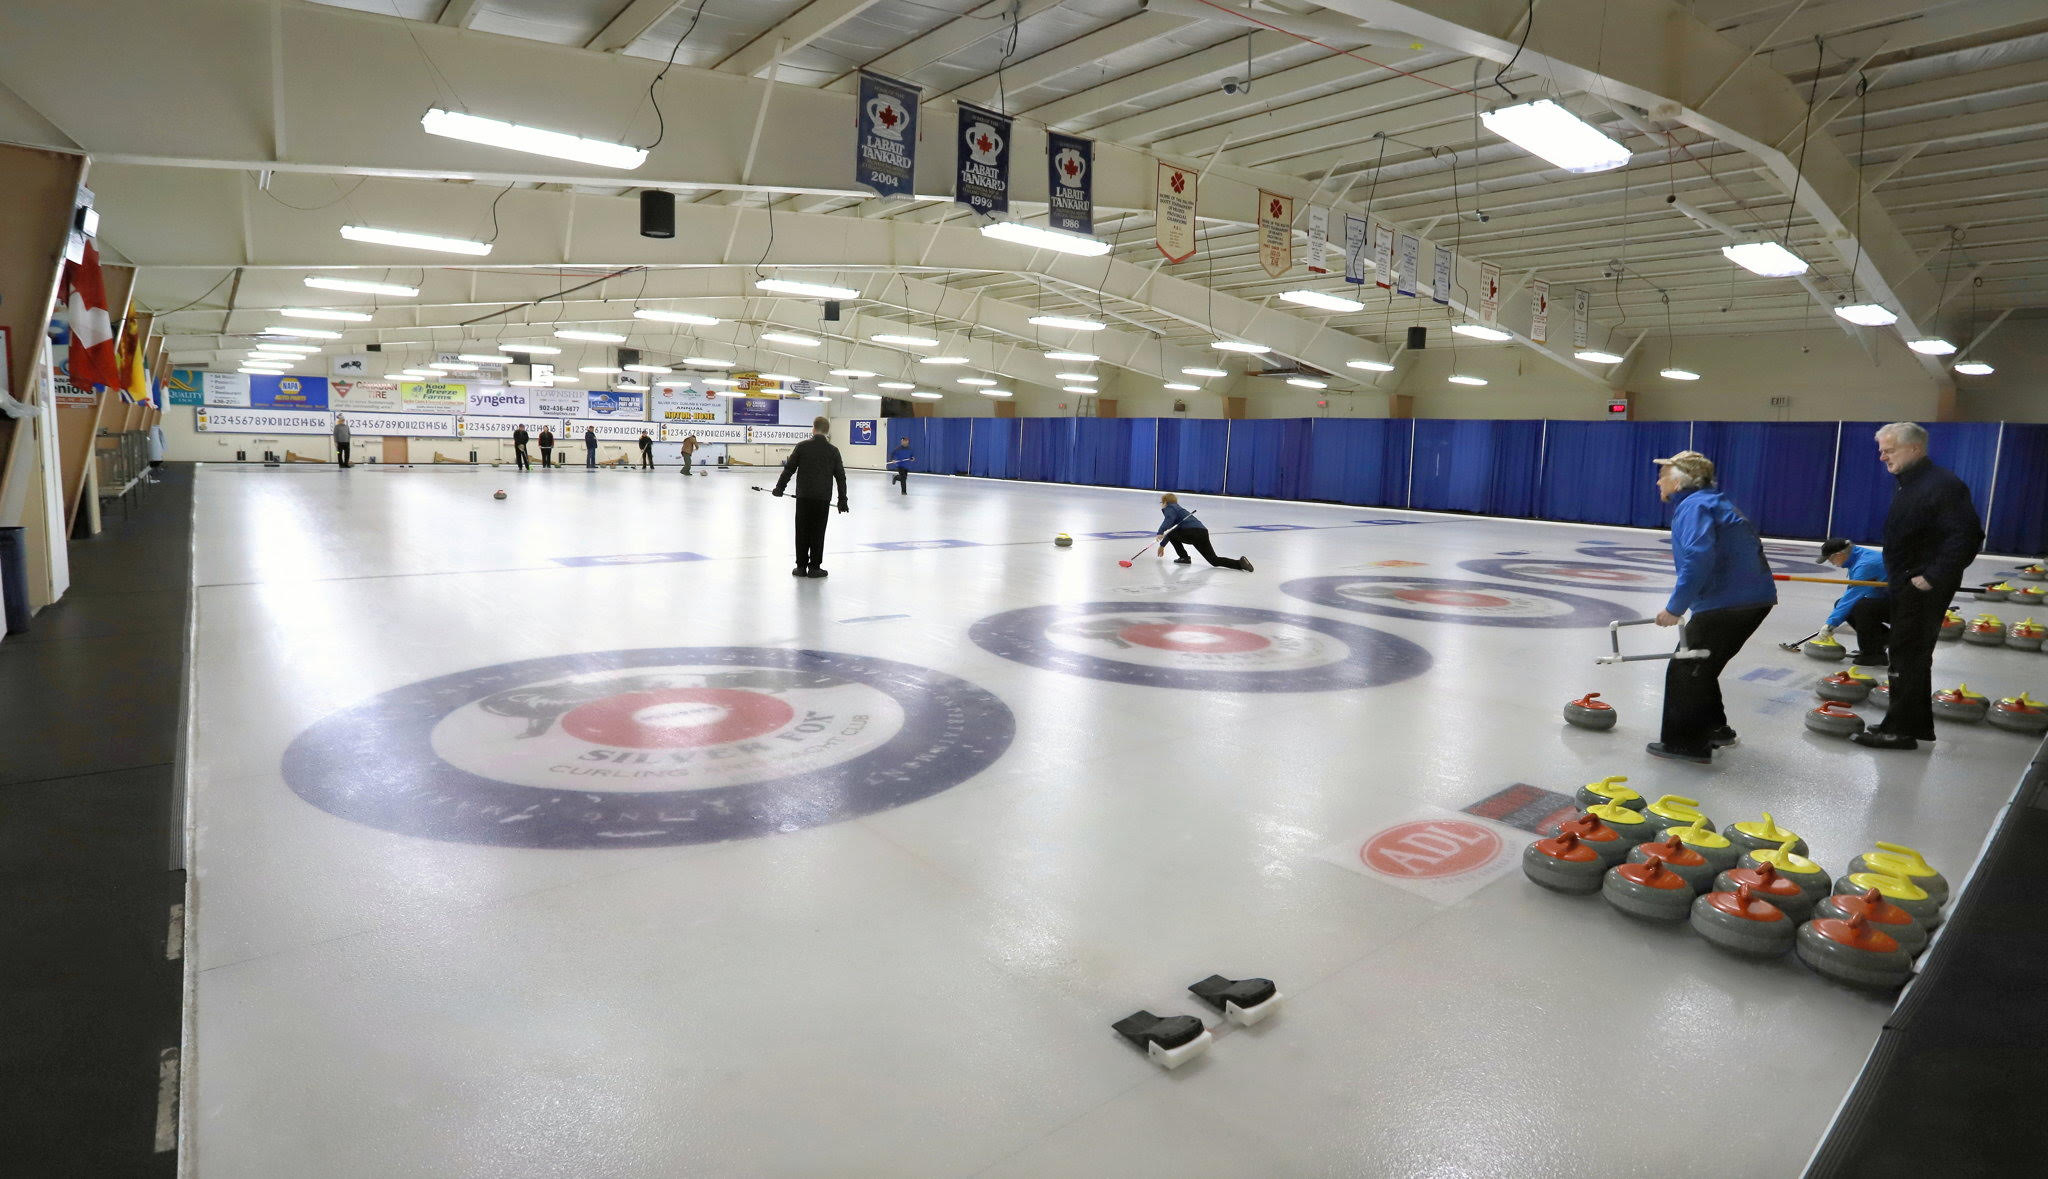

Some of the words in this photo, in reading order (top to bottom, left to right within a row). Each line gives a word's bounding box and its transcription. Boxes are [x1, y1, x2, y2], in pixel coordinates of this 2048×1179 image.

[861, 145, 911, 169] TANKARD
[871, 171, 899, 187] 2004
[961, 170, 1006, 191] TANKARD
[1051, 196, 1089, 211] TANKARD
[1062, 219, 1080, 229] 1986
[282, 381, 299, 391] NAPA
[168, 391, 203, 399] QUALITY
[470, 394, 526, 406] syngenta
[855, 420, 871, 428] PEPSI
[577, 741, 772, 763] SILVER
[776, 711, 835, 742] FOX
[549, 764, 690, 778] CURLING
[1378, 826, 1490, 874] ADL
